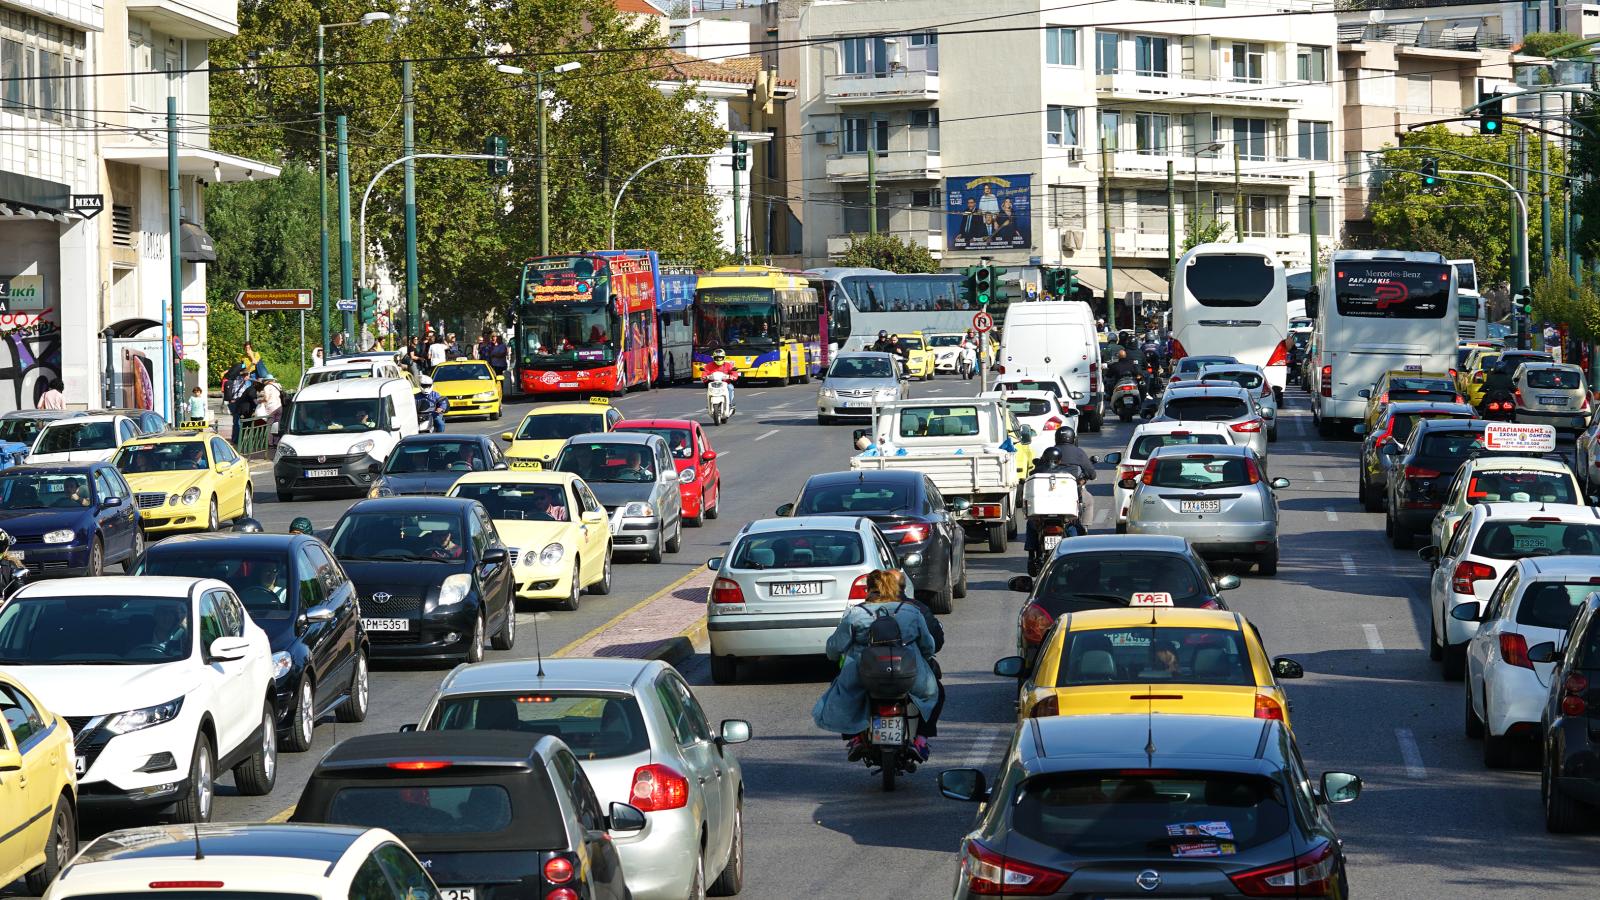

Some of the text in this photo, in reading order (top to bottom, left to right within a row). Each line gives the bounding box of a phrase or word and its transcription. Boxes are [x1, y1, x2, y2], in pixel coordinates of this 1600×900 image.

[1365, 270, 1421, 279] Mercedes-Benz
[1487, 426, 1544, 434] ΠΑΠΑΓΙΑΝΝΙΔΗΣ
[881, 733, 902, 742] 542
